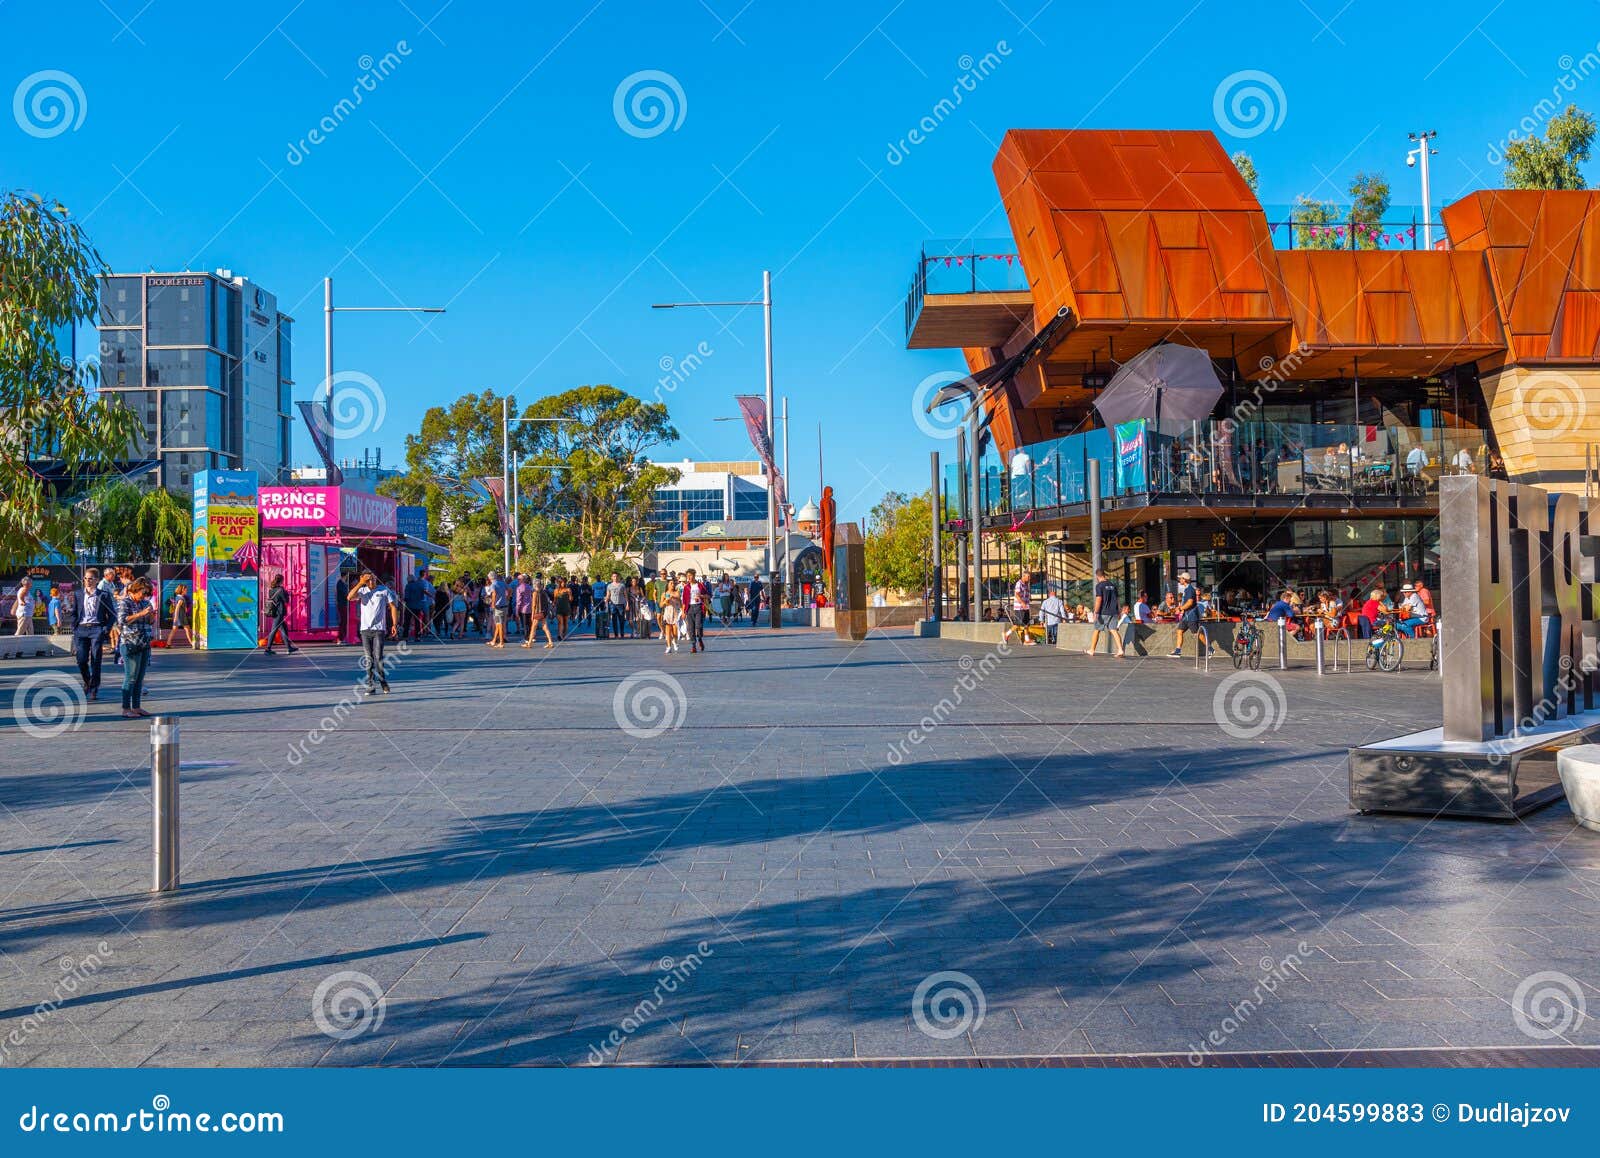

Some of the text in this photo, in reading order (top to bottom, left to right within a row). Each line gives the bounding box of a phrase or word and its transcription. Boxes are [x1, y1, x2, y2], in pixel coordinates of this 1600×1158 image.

[260, 492, 326, 507] FRINGE
[262, 507, 326, 520] WORLD
[345, 494, 393, 527] BOX OFFICE
[209, 515, 255, 526] FRINGE
[218, 525, 245, 536] CAT
